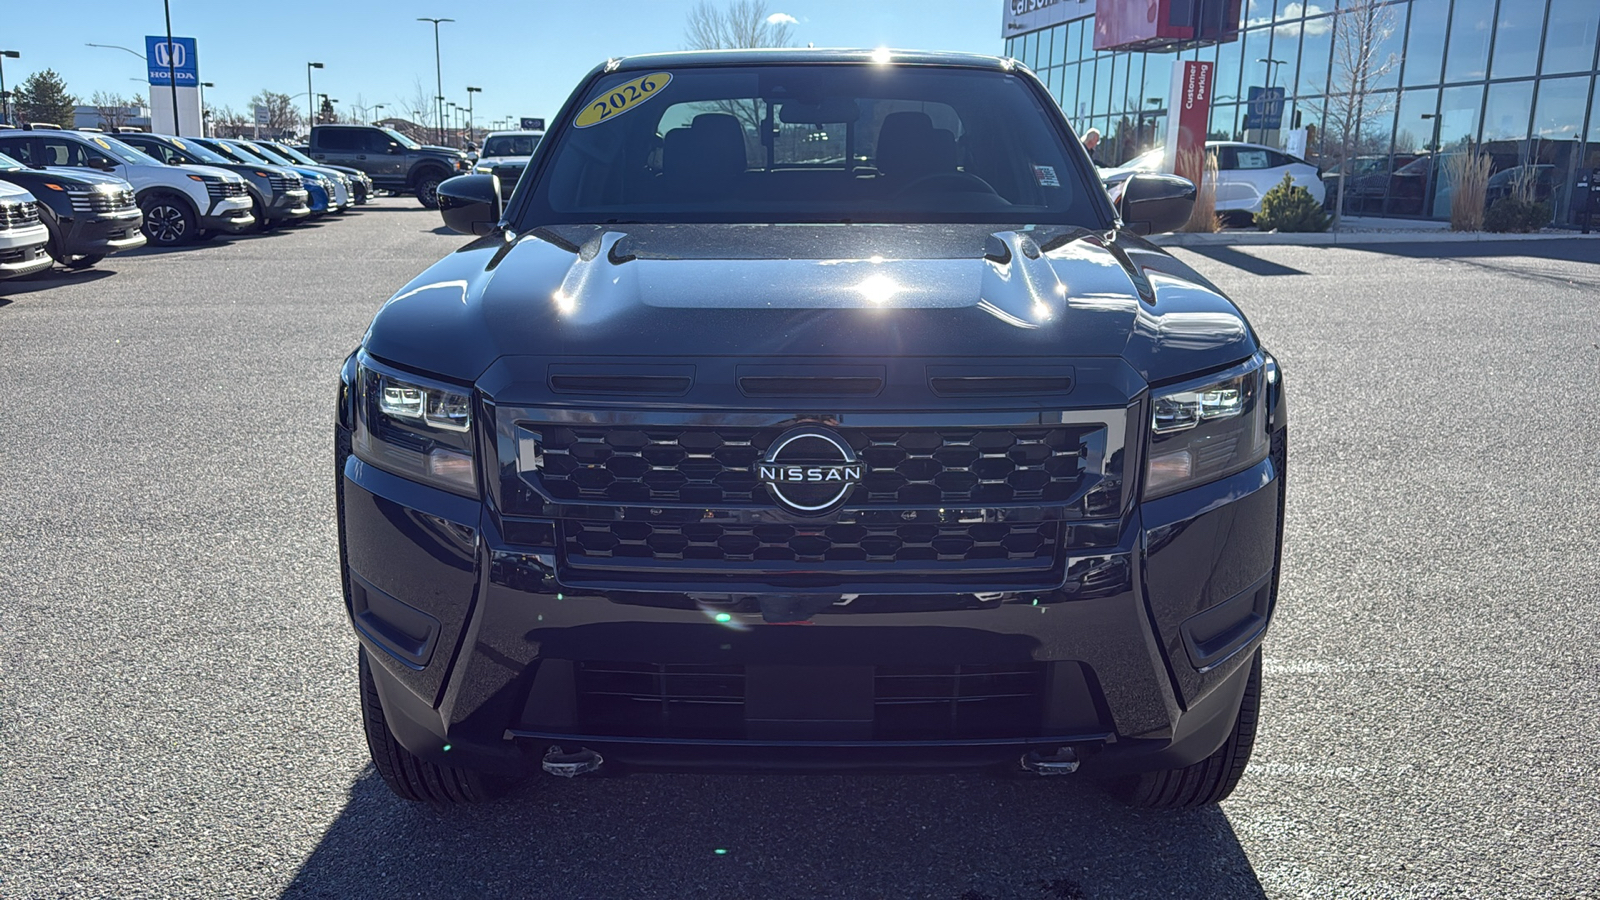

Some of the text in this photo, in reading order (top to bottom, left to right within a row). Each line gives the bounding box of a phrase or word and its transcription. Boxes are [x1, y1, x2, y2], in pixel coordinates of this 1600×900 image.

[593, 77, 656, 120] 2026
[1185, 64, 1196, 110] Customer
[1197, 64, 1208, 100] Parking
[760, 466, 860, 481] NISSAN
